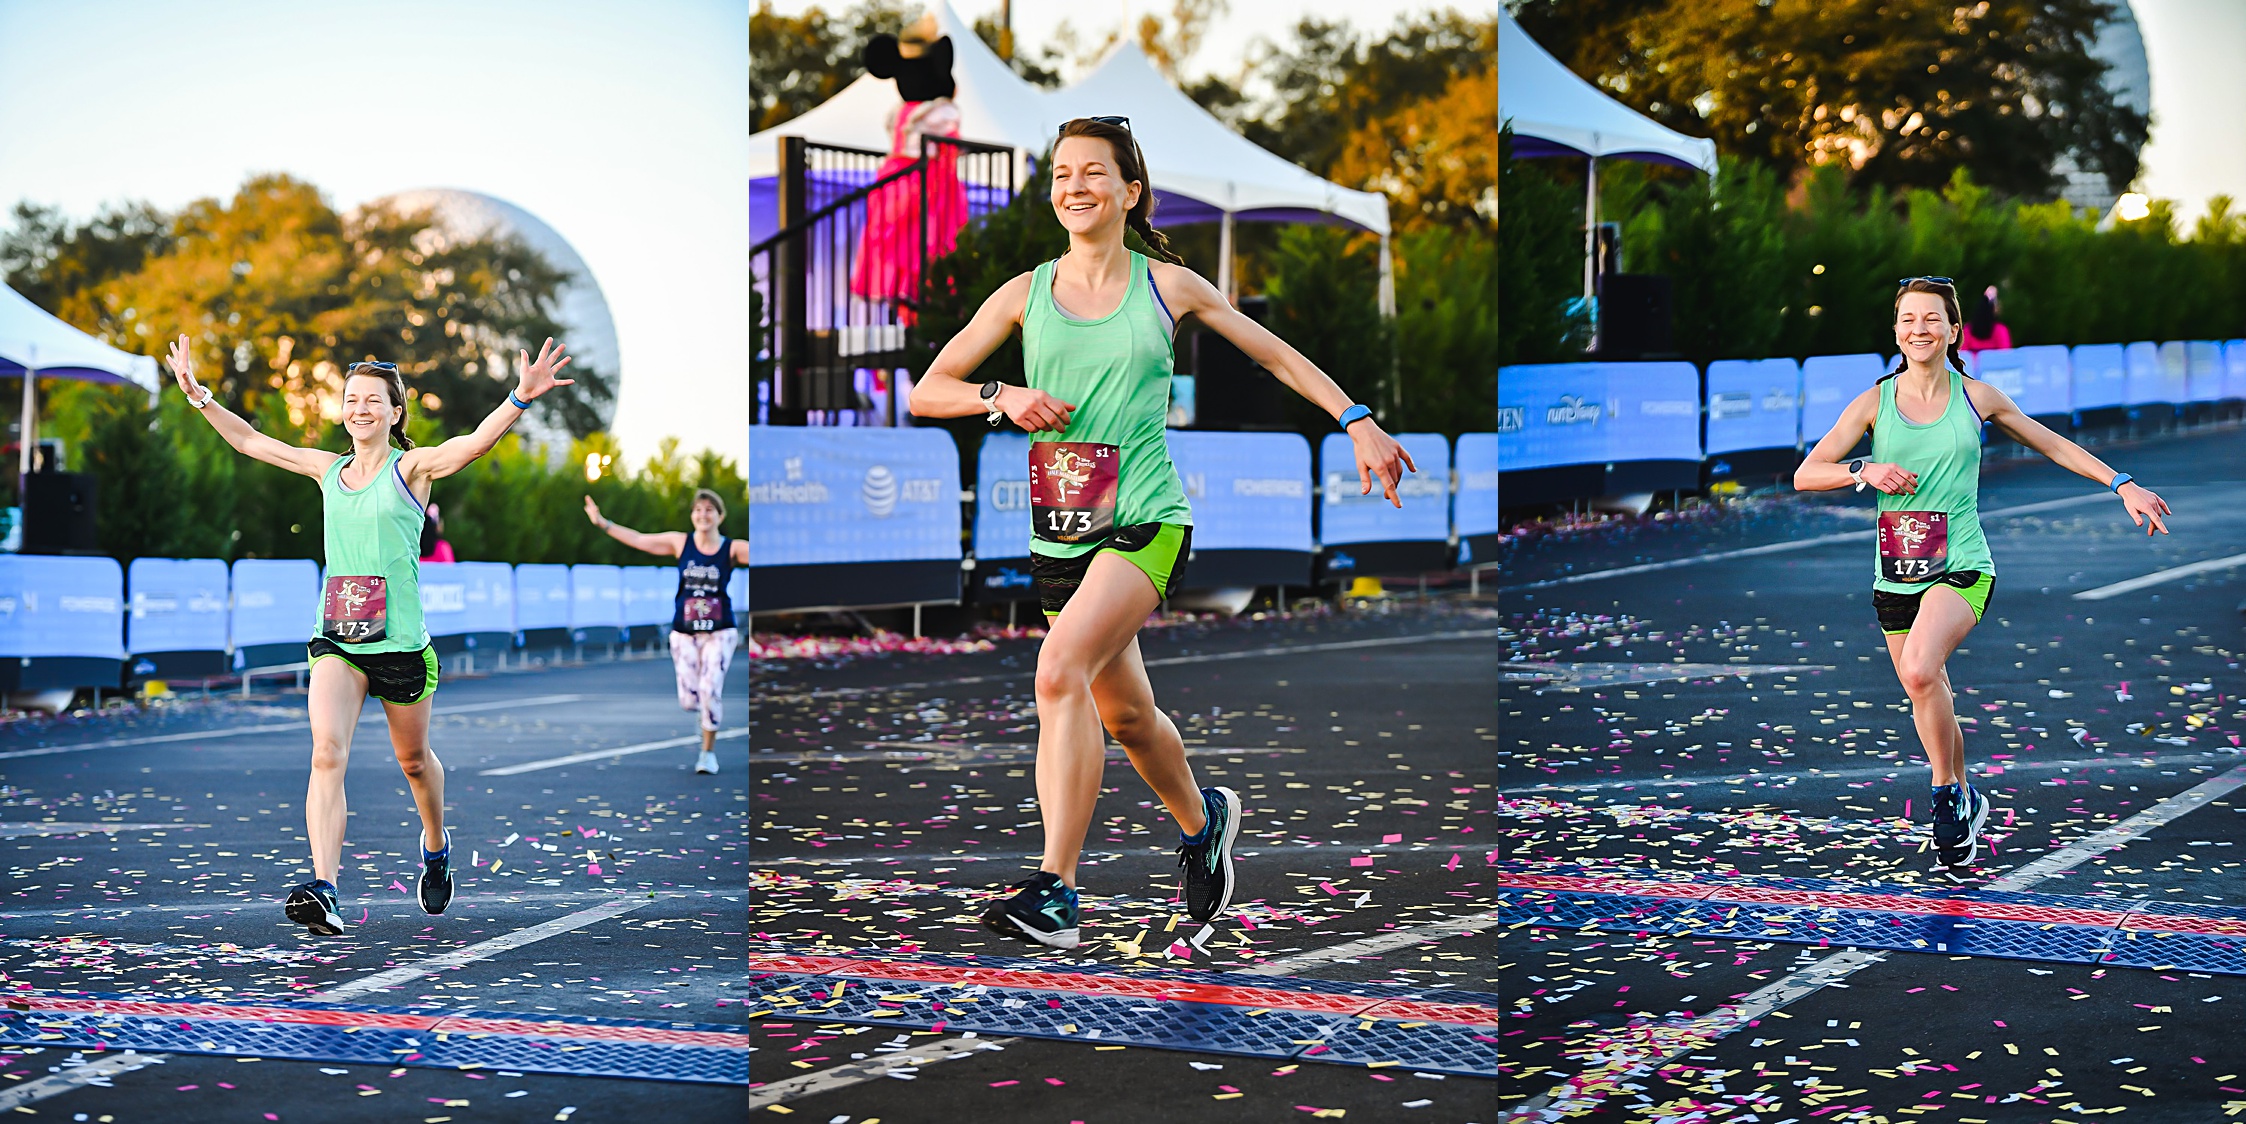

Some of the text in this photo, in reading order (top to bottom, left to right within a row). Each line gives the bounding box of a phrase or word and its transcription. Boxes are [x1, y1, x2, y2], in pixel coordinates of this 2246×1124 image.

[901, 479, 943, 502] AT&T
[1048, 511, 1091, 531] 173
[1894, 560, 1929, 575] 173
[336, 622, 370, 635] 173
